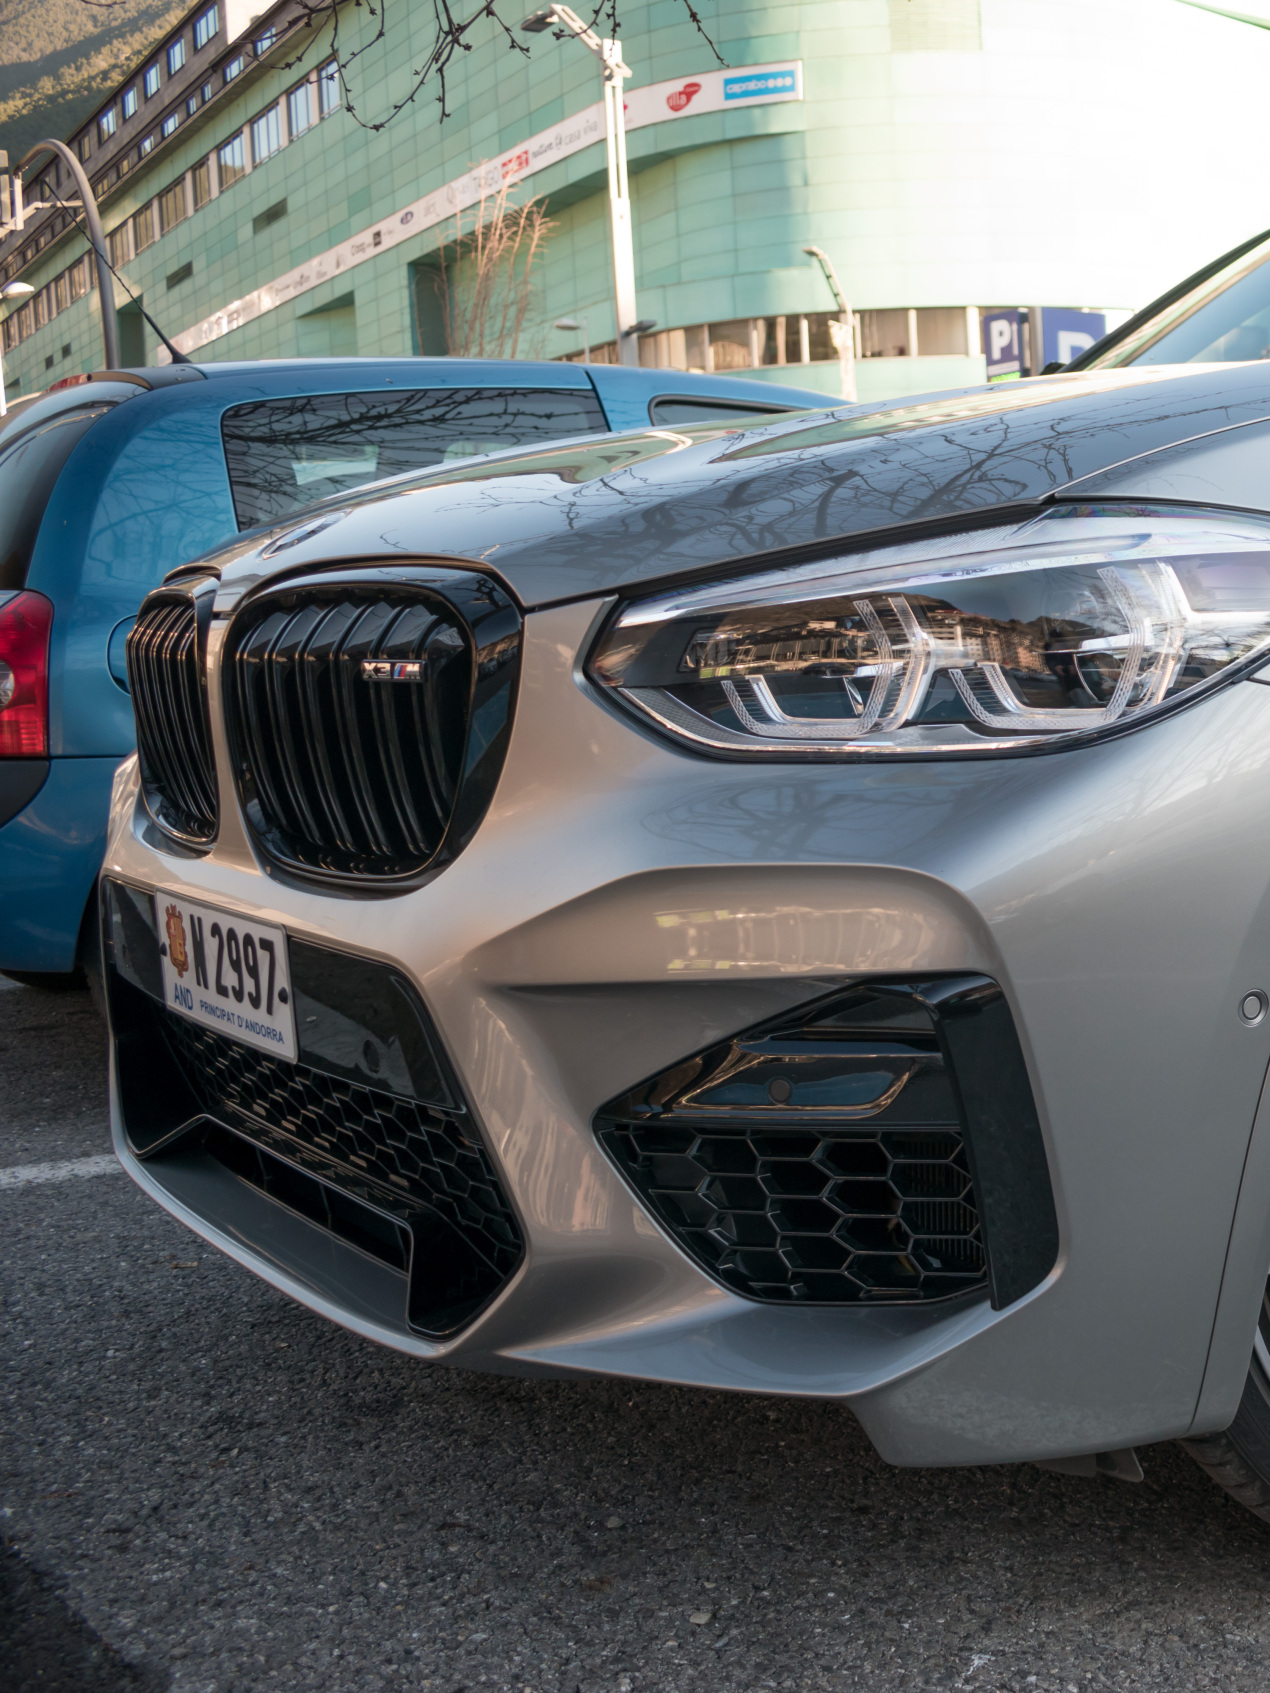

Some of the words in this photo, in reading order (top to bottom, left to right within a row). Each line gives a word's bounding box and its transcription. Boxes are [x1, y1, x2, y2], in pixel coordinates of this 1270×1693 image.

[726, 79, 767, 94] caprabo
[210, 922, 276, 1016] 2997
[174, 983, 194, 1011] AND
[200, 999, 236, 1027] PRINCIPAT
[237, 1016, 285, 1044] D'ANDORRA
